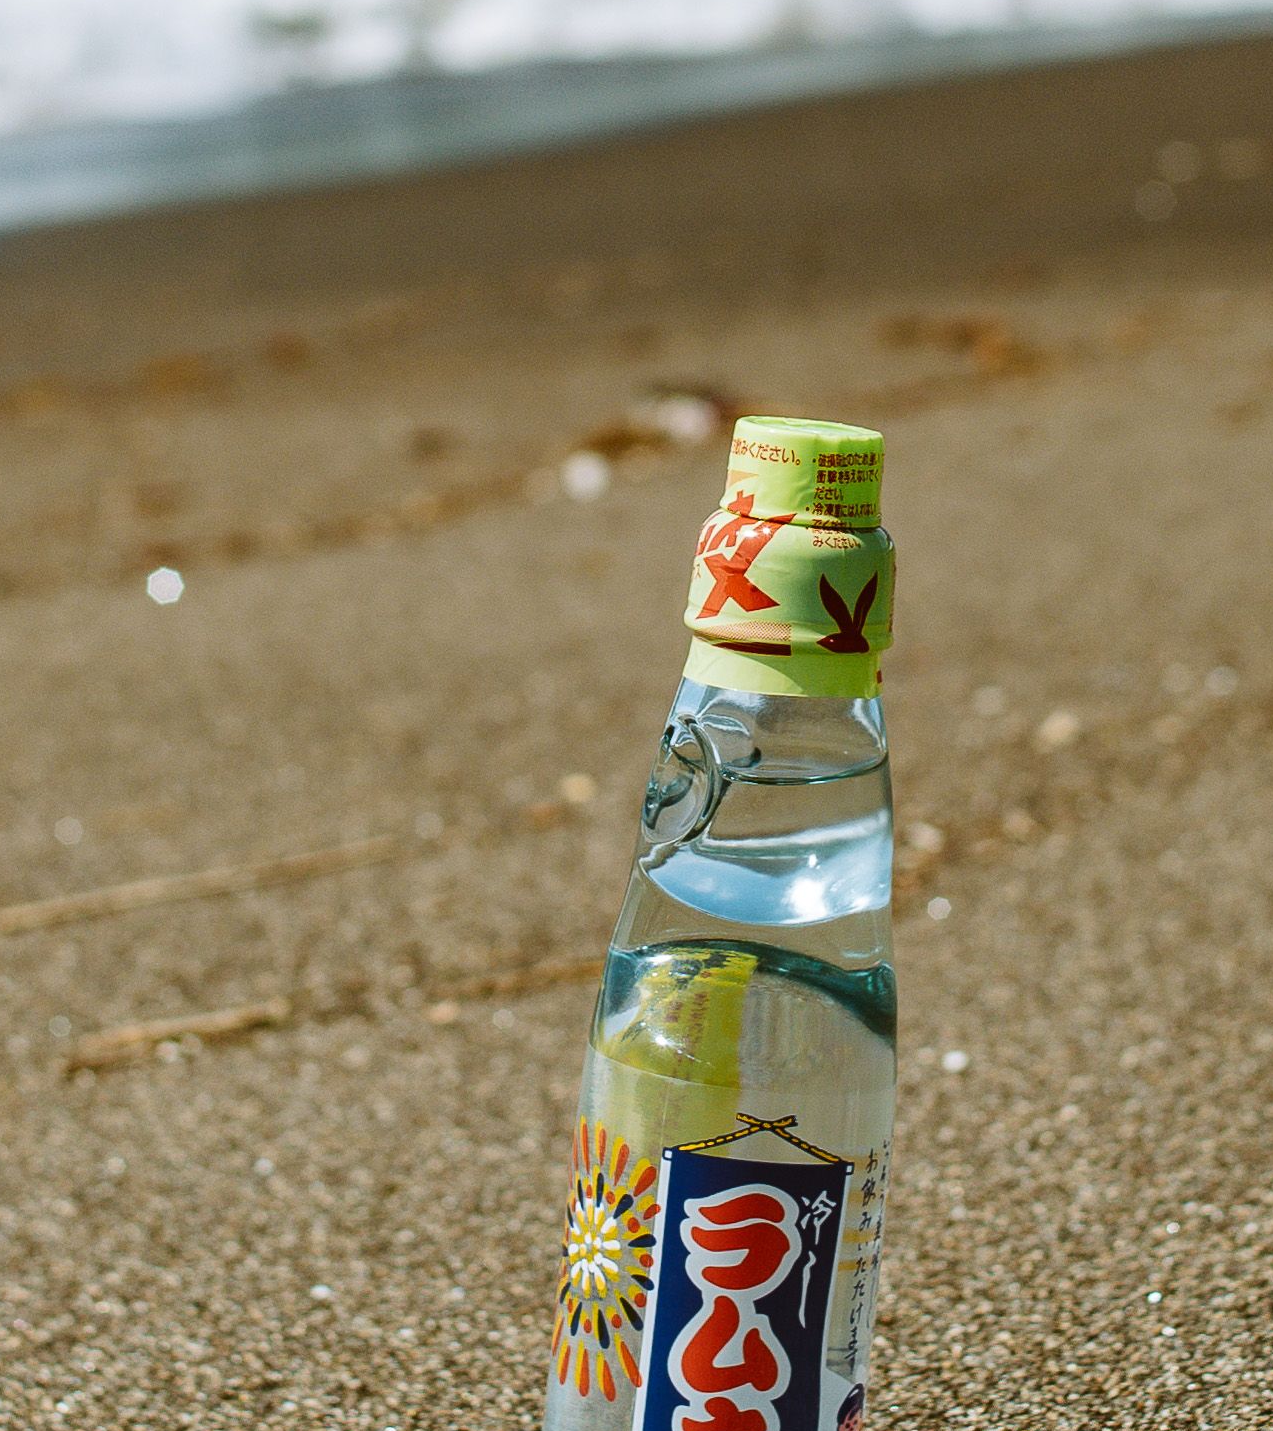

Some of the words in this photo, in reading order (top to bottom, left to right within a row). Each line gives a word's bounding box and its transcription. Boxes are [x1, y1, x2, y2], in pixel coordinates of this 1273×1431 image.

[845, 1148, 877, 1375] お飲みいただけます
